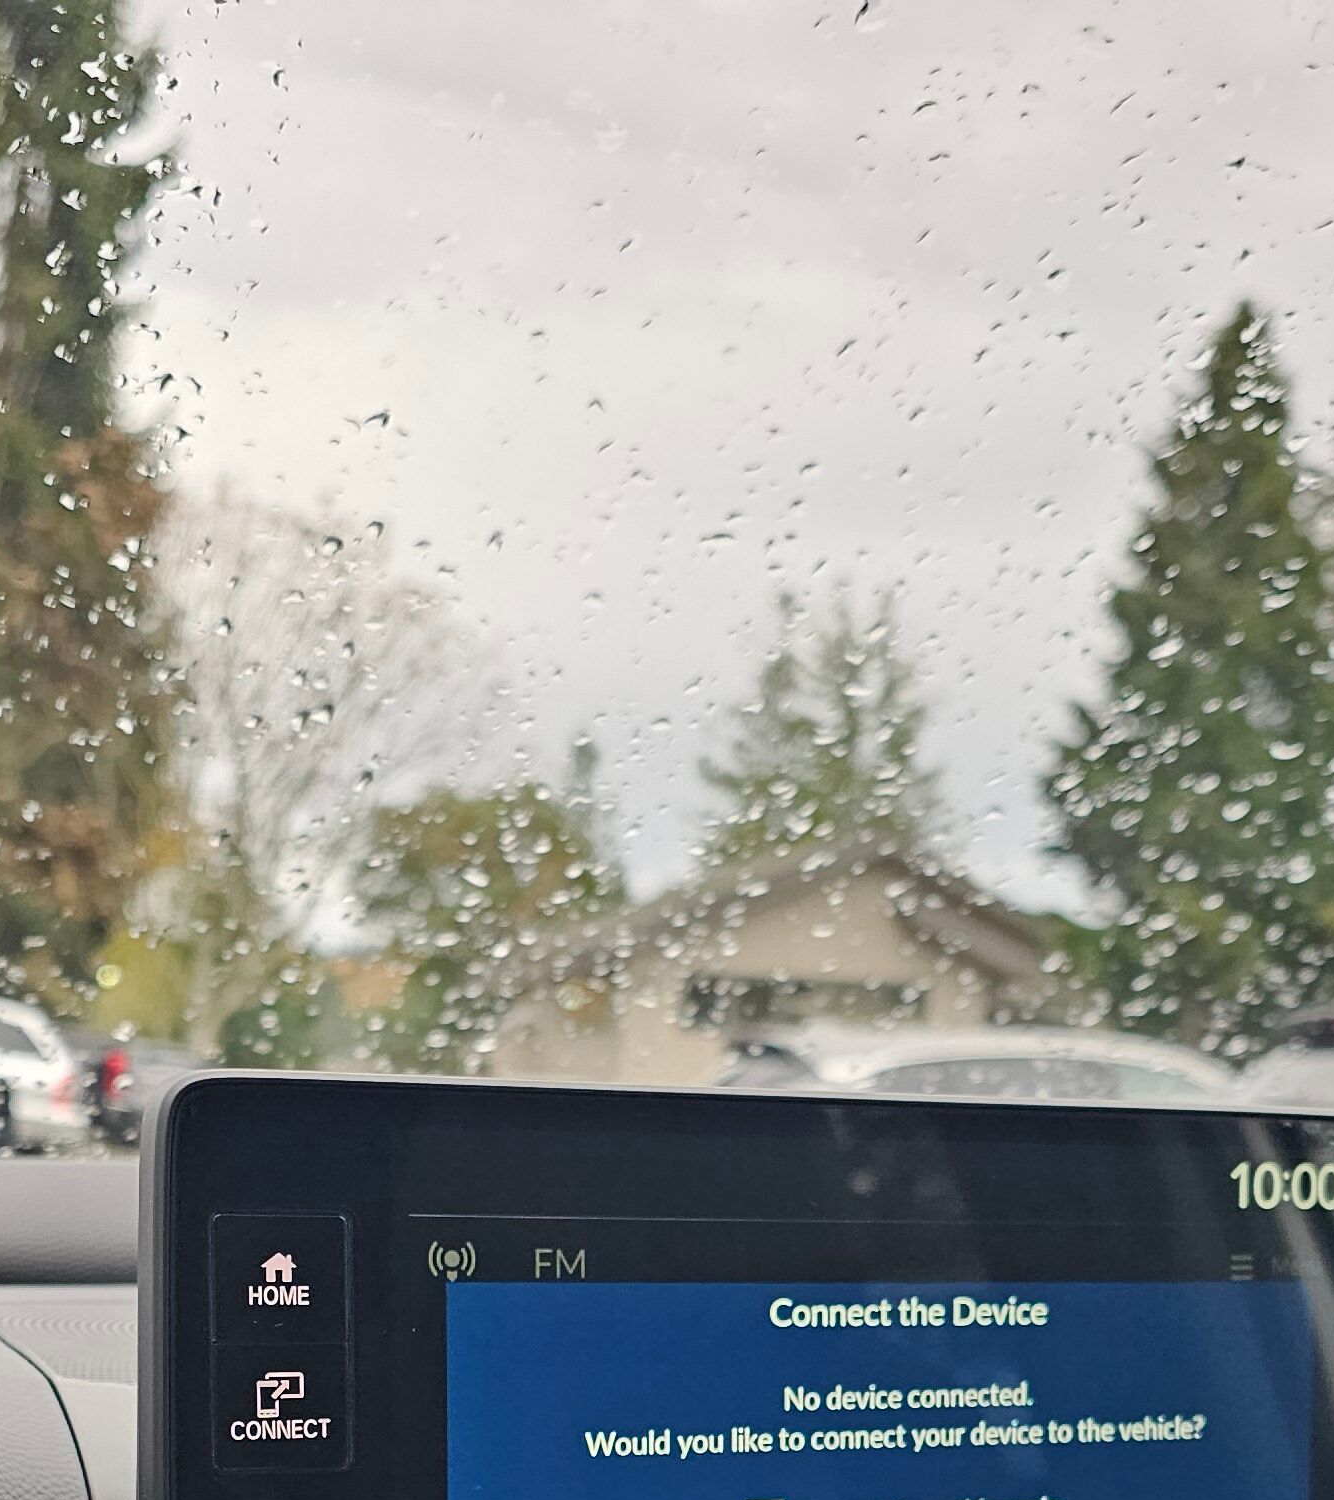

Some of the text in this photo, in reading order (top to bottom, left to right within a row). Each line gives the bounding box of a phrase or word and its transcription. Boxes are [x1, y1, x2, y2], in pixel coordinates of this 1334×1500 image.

[534, 1248, 586, 1279] FM
[248, 1285, 310, 1306] HOME
[769, 1295, 1049, 1328] Connect the Device
[783, 1380, 1034, 1412] No device connected.
[230, 1413, 332, 1441] CONNECT
[584, 1414, 1207, 1460] Would you like to connect your device to the vehicle?
